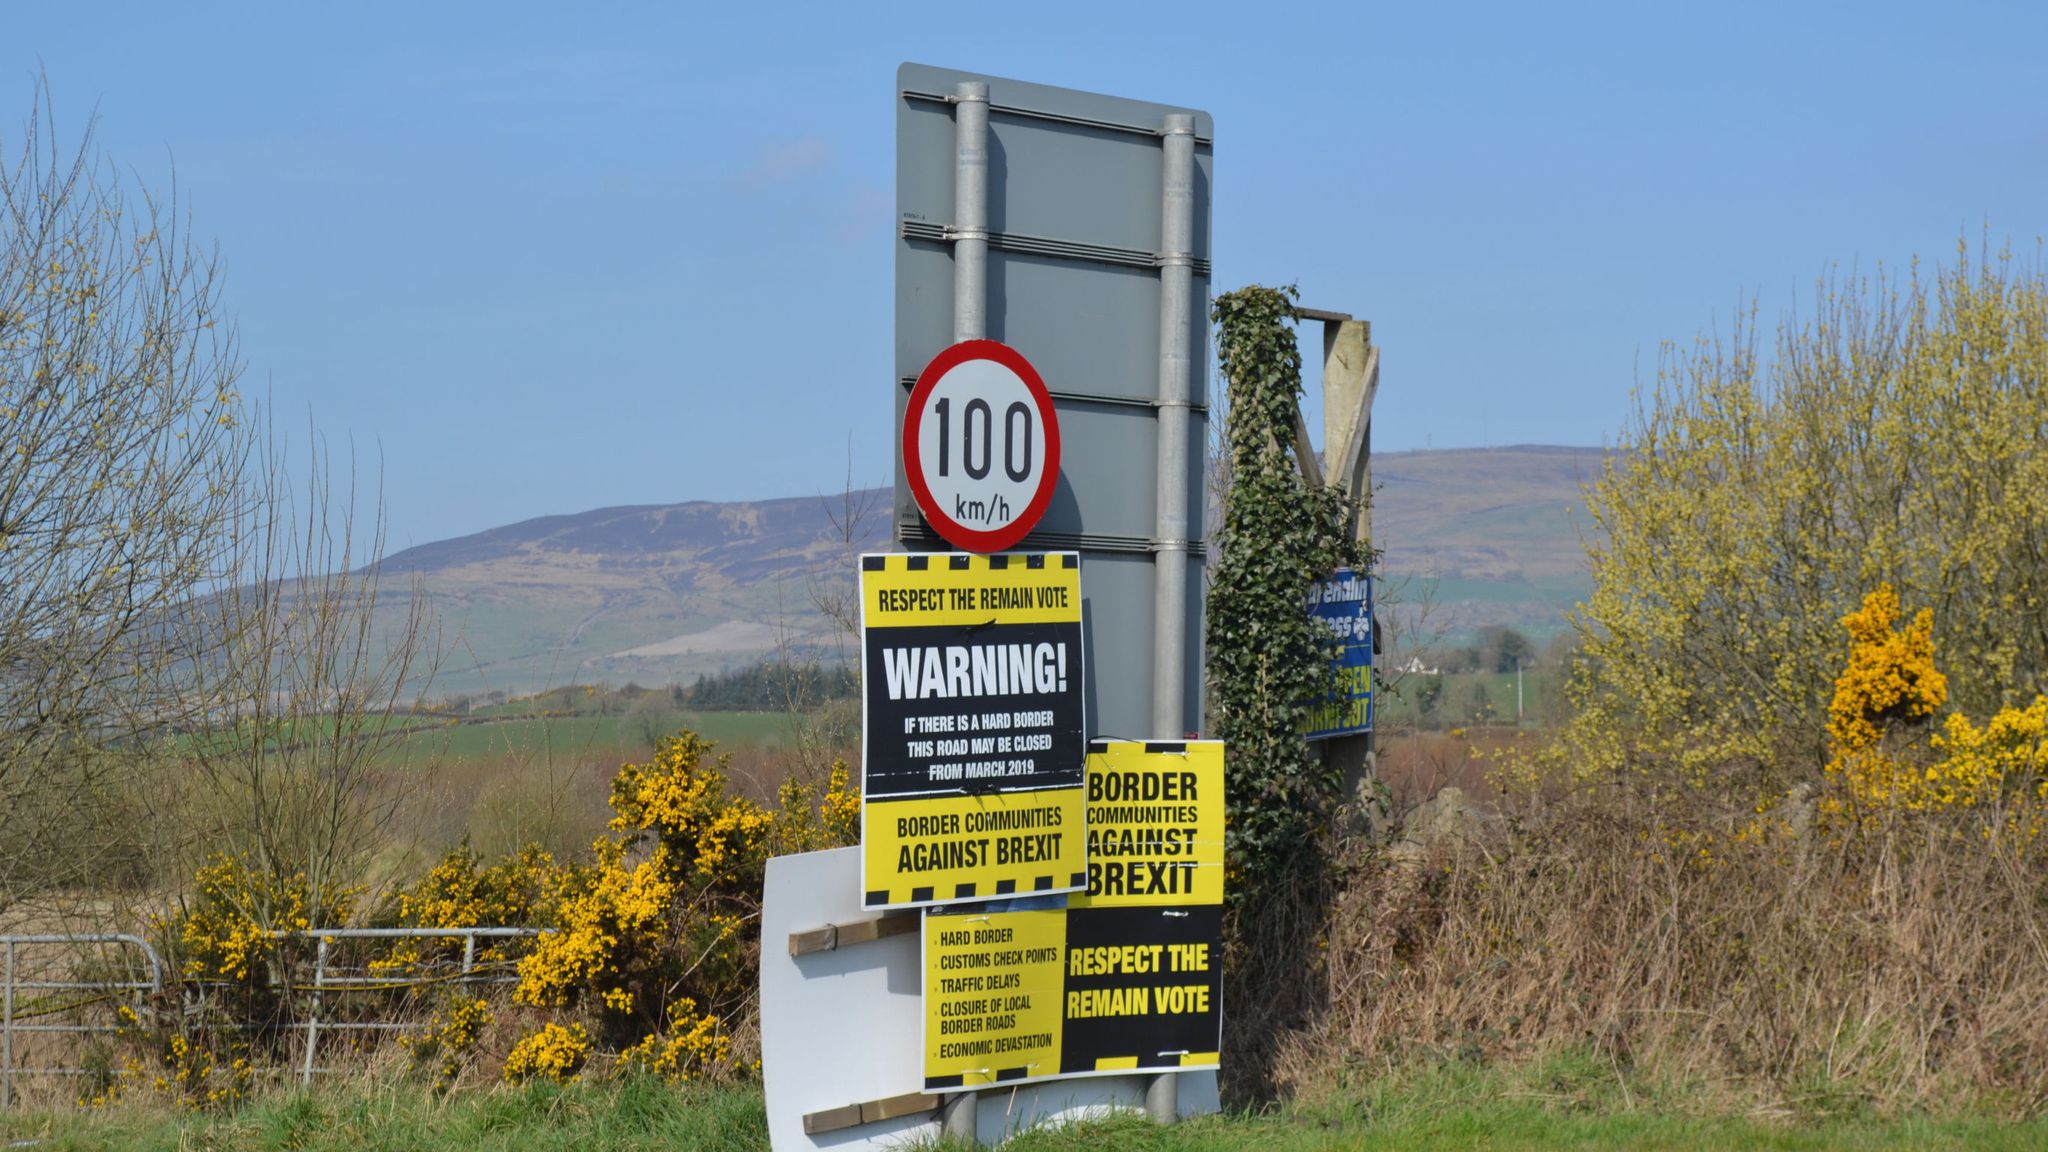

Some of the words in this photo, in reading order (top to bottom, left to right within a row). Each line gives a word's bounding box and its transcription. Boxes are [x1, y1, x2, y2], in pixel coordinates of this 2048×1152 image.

[935, 398, 1032, 483] 100
[956, 493, 1010, 525] km/h
[879, 588, 945, 612] RESPECT
[949, 588, 975, 610] THE
[980, 587, 1033, 609] REMAIN
[1036, 586, 1068, 608] VOTE
[882, 642, 1067, 700] WARNING!
[904, 717, 916, 734] IF
[918, 715, 954, 733] THERE
[957, 714, 969, 732] IS
[971, 714, 979, 731] A
[981, 712, 1010, 730] HARD
[1013, 710, 1054, 728] BORDER
[907, 741, 934, 758] THIS
[936, 739, 969, 757] ROAD
[971, 738, 995, 756] MAY
[998, 736, 1012, 753] BE
[1014, 734, 1052, 751] CLOSED
[929, 763, 963, 781] FROM
[965, 760, 1005, 779] MARCH
[1008, 759, 1035, 776] 2019
[1088, 772, 1198, 802] BORDER
[897, 815, 960, 838] BORDER
[965, 806, 1062, 833] COMMUNITIES
[1087, 805, 1198, 825] COMMUNITIES
[897, 838, 989, 874] AGAINST
[997, 833, 1063, 865] BREXIT
[1087, 828, 1198, 857] AGAINST
[1085, 861, 1199, 897] BREXIT
[940, 931, 971, 947] HARD
[974, 928, 1013, 944] BORDER
[940, 952, 991, 970] CUSTOMS
[993, 950, 1023, 967] CHECK
[1025, 947, 1057, 964] POINTS
[1070, 944, 1163, 976] RESPECT
[1167, 943, 1208, 972] THE
[940, 976, 983, 994] TRAFFIC
[986, 973, 1020, 990] DELAYS
[940, 999, 987, 1017] CLOSURE
[990, 998, 1002, 1013] OF
[1004, 995, 1031, 1012] LOCAL
[1067, 987, 1149, 1019] REMAIN
[1154, 985, 1209, 1014] VOTE
[941, 1018, 983, 1035] BORDER
[985, 1014, 1016, 1031] ROADS
[940, 1039, 992, 1059] ECONOMIC
[995, 1032, 1053, 1053] DEVASTATION
